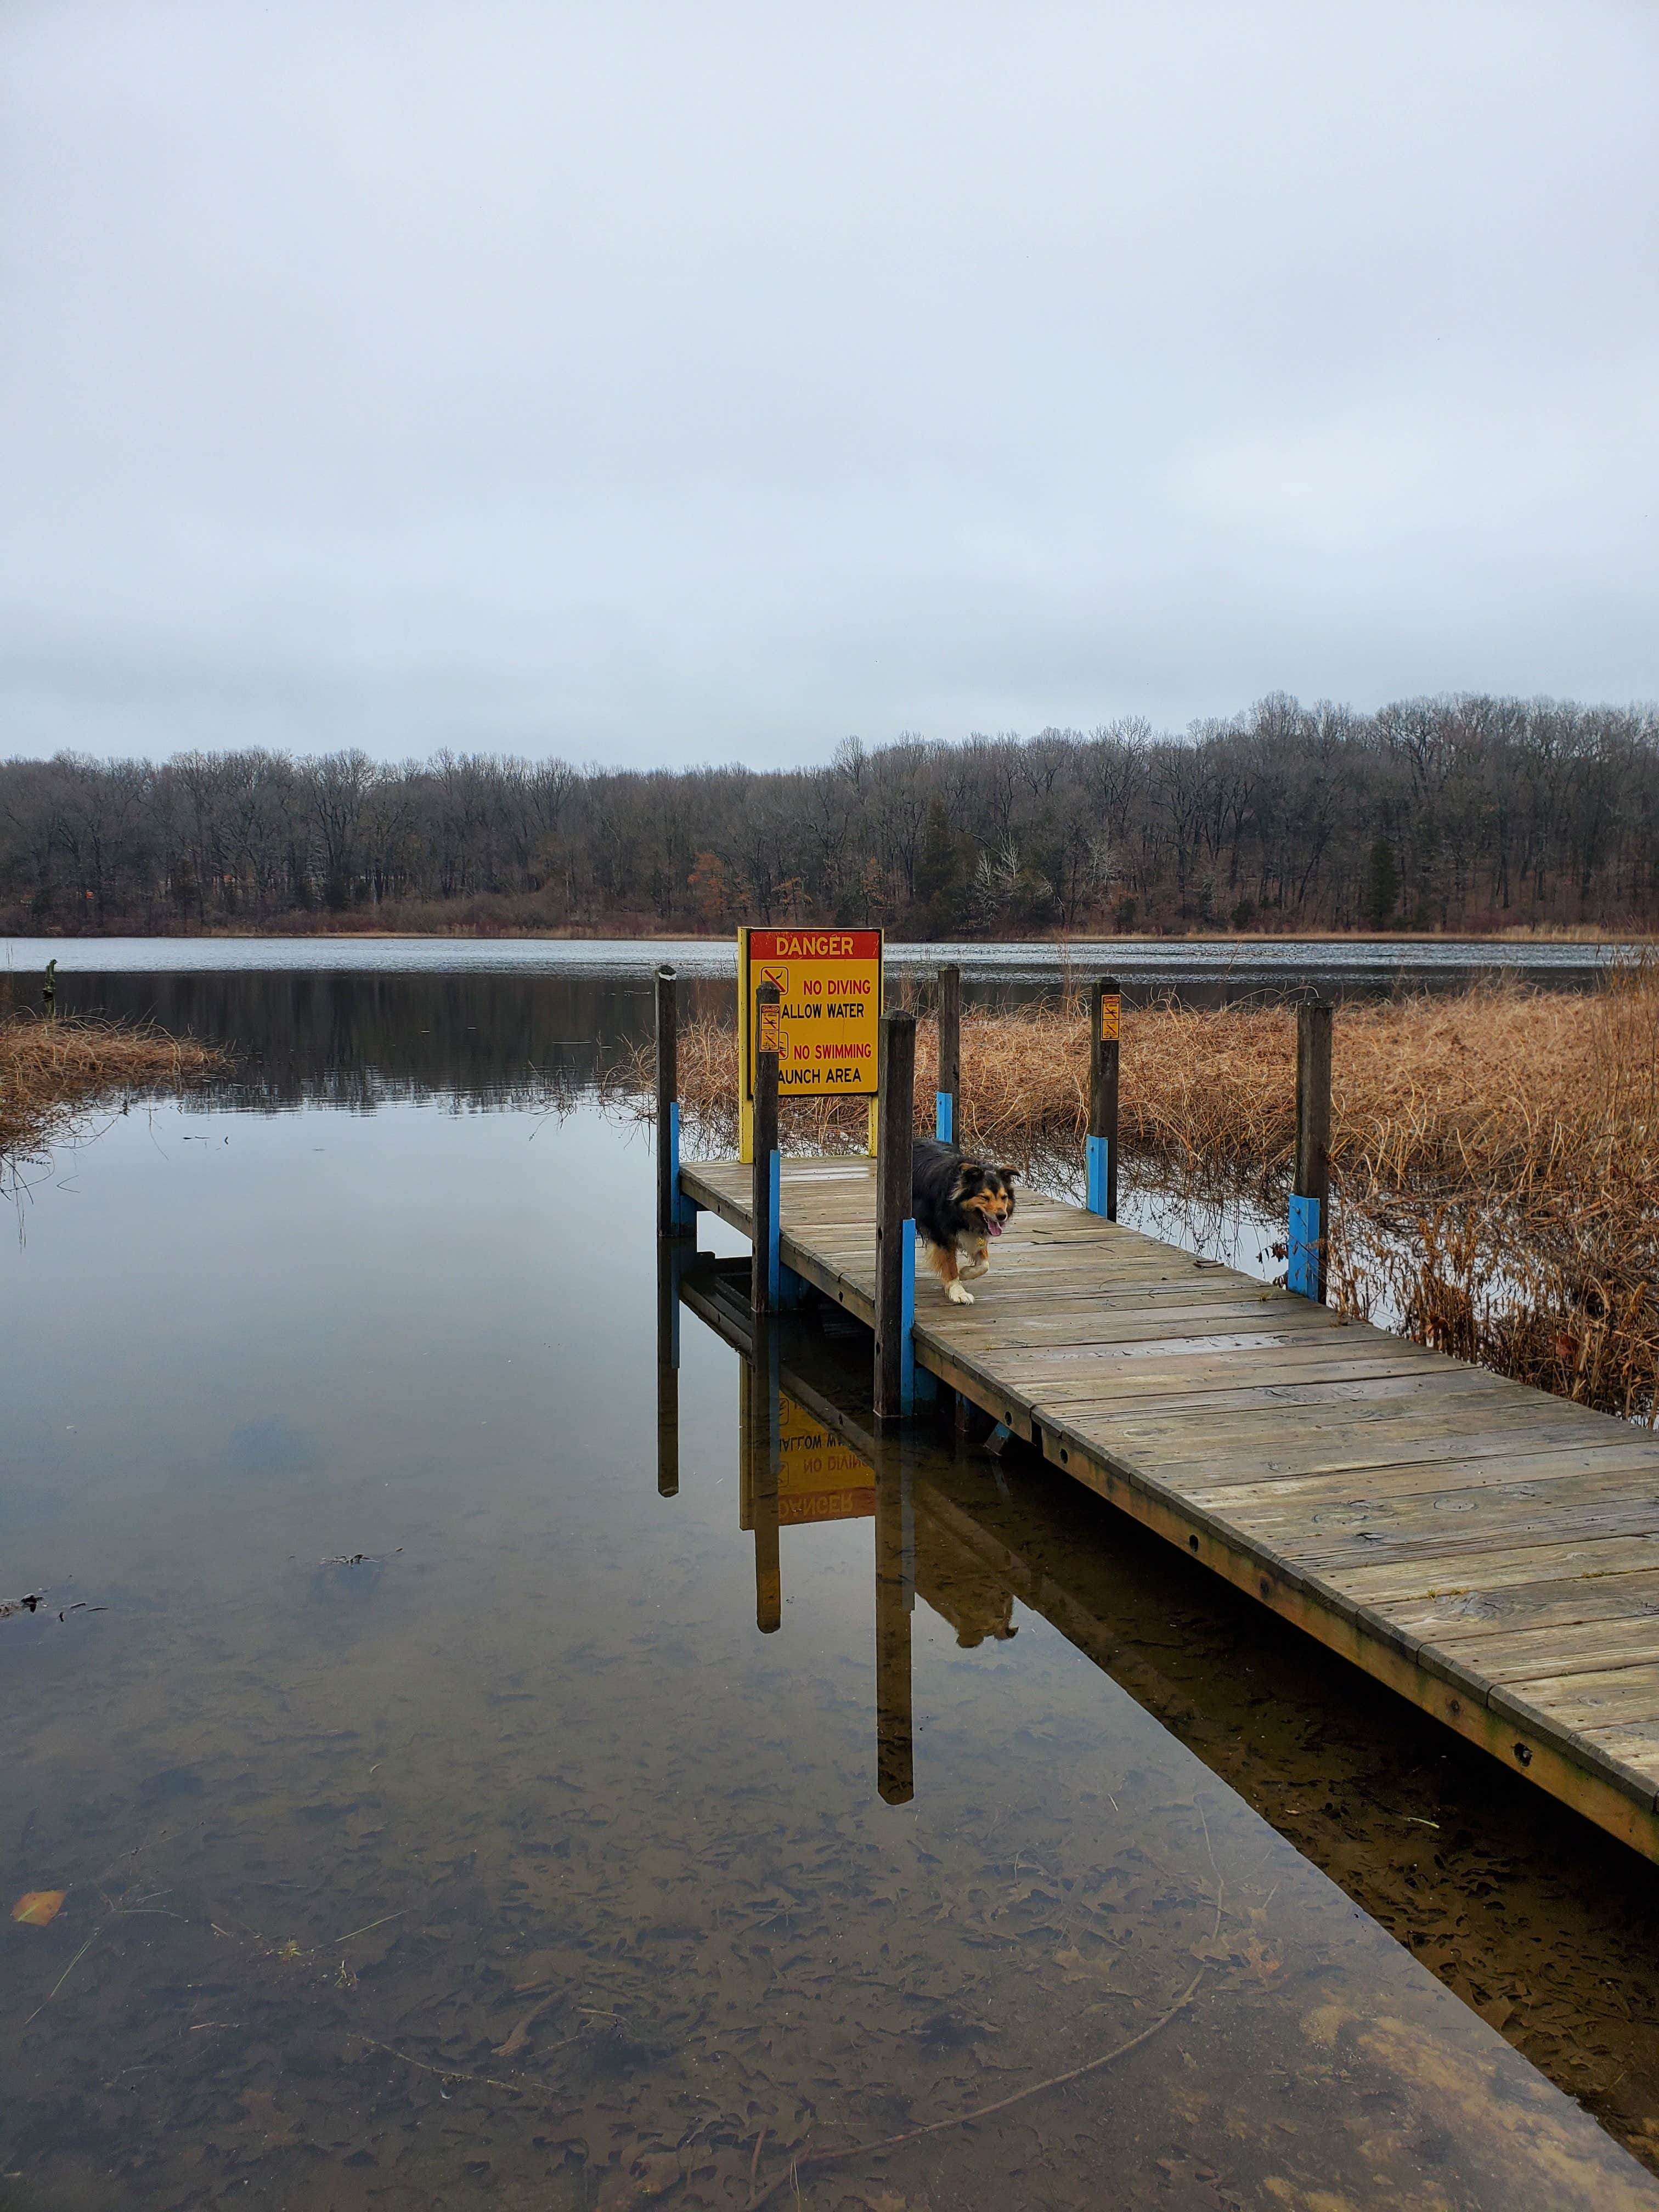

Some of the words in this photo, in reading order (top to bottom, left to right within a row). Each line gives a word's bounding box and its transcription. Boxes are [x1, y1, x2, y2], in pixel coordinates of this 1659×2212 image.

[776, 936, 854, 956] DANGER
[804, 980, 822, 995] NO
[827, 979, 871, 995] DIVING
[781, 1003, 822, 1019] ALLOW
[827, 1003, 864, 1018] WATER
[794, 1045, 810, 1060] NO
[815, 1043, 872, 1059] SWIMMING
[778, 1069, 821, 1085] AUNCH
[825, 1068, 862, 1083] AREA
